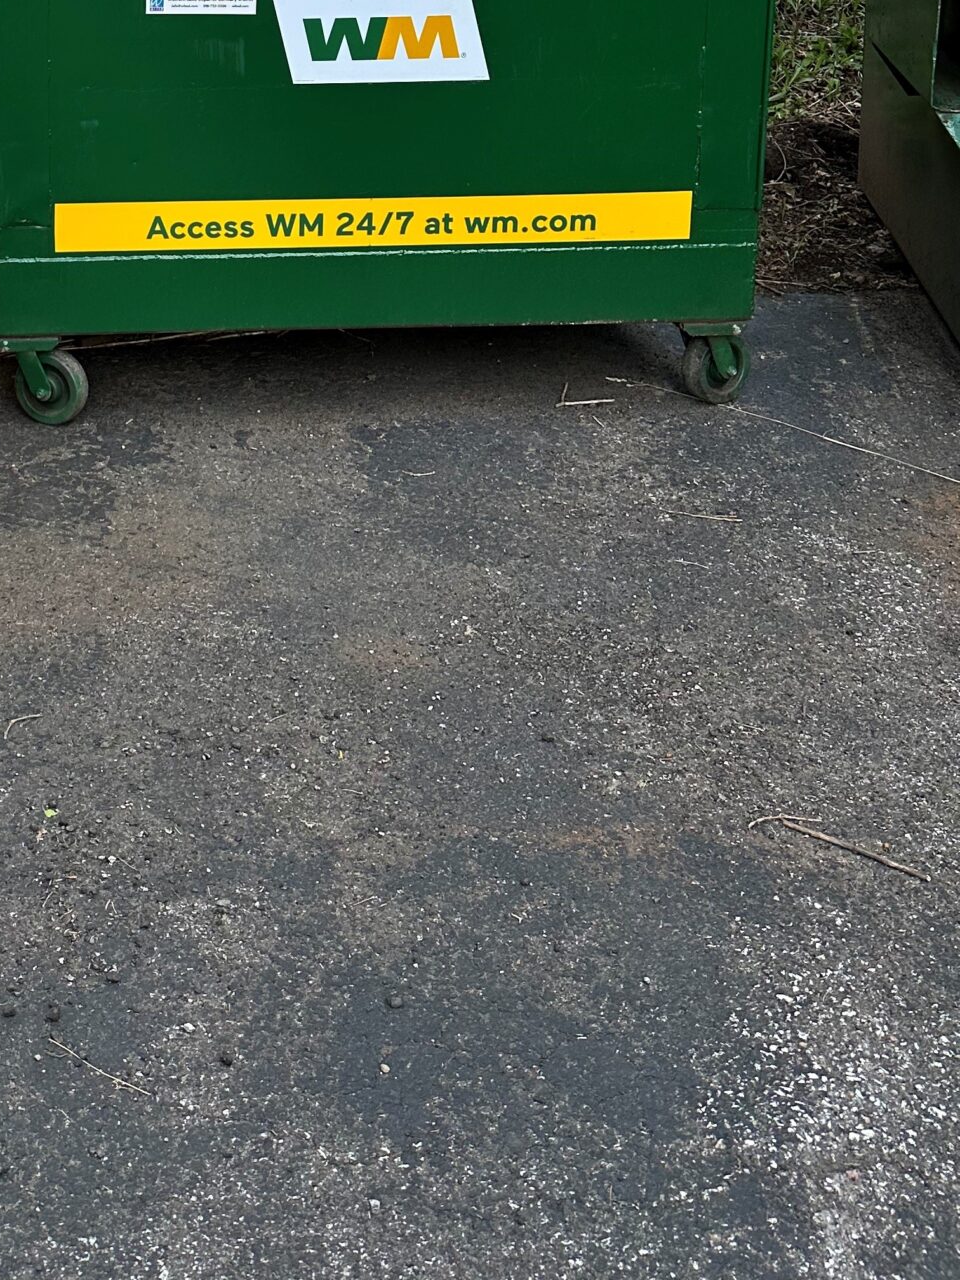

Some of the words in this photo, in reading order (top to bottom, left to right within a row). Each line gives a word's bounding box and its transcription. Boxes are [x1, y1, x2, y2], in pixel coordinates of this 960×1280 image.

[303, 15, 460, 61] WM
[146, 215, 255, 239] Access
[265, 213, 324, 237] WM
[336, 211, 414, 236] 24/7
[424, 213, 453, 234] at
[464, 214, 596, 233] wm.com
